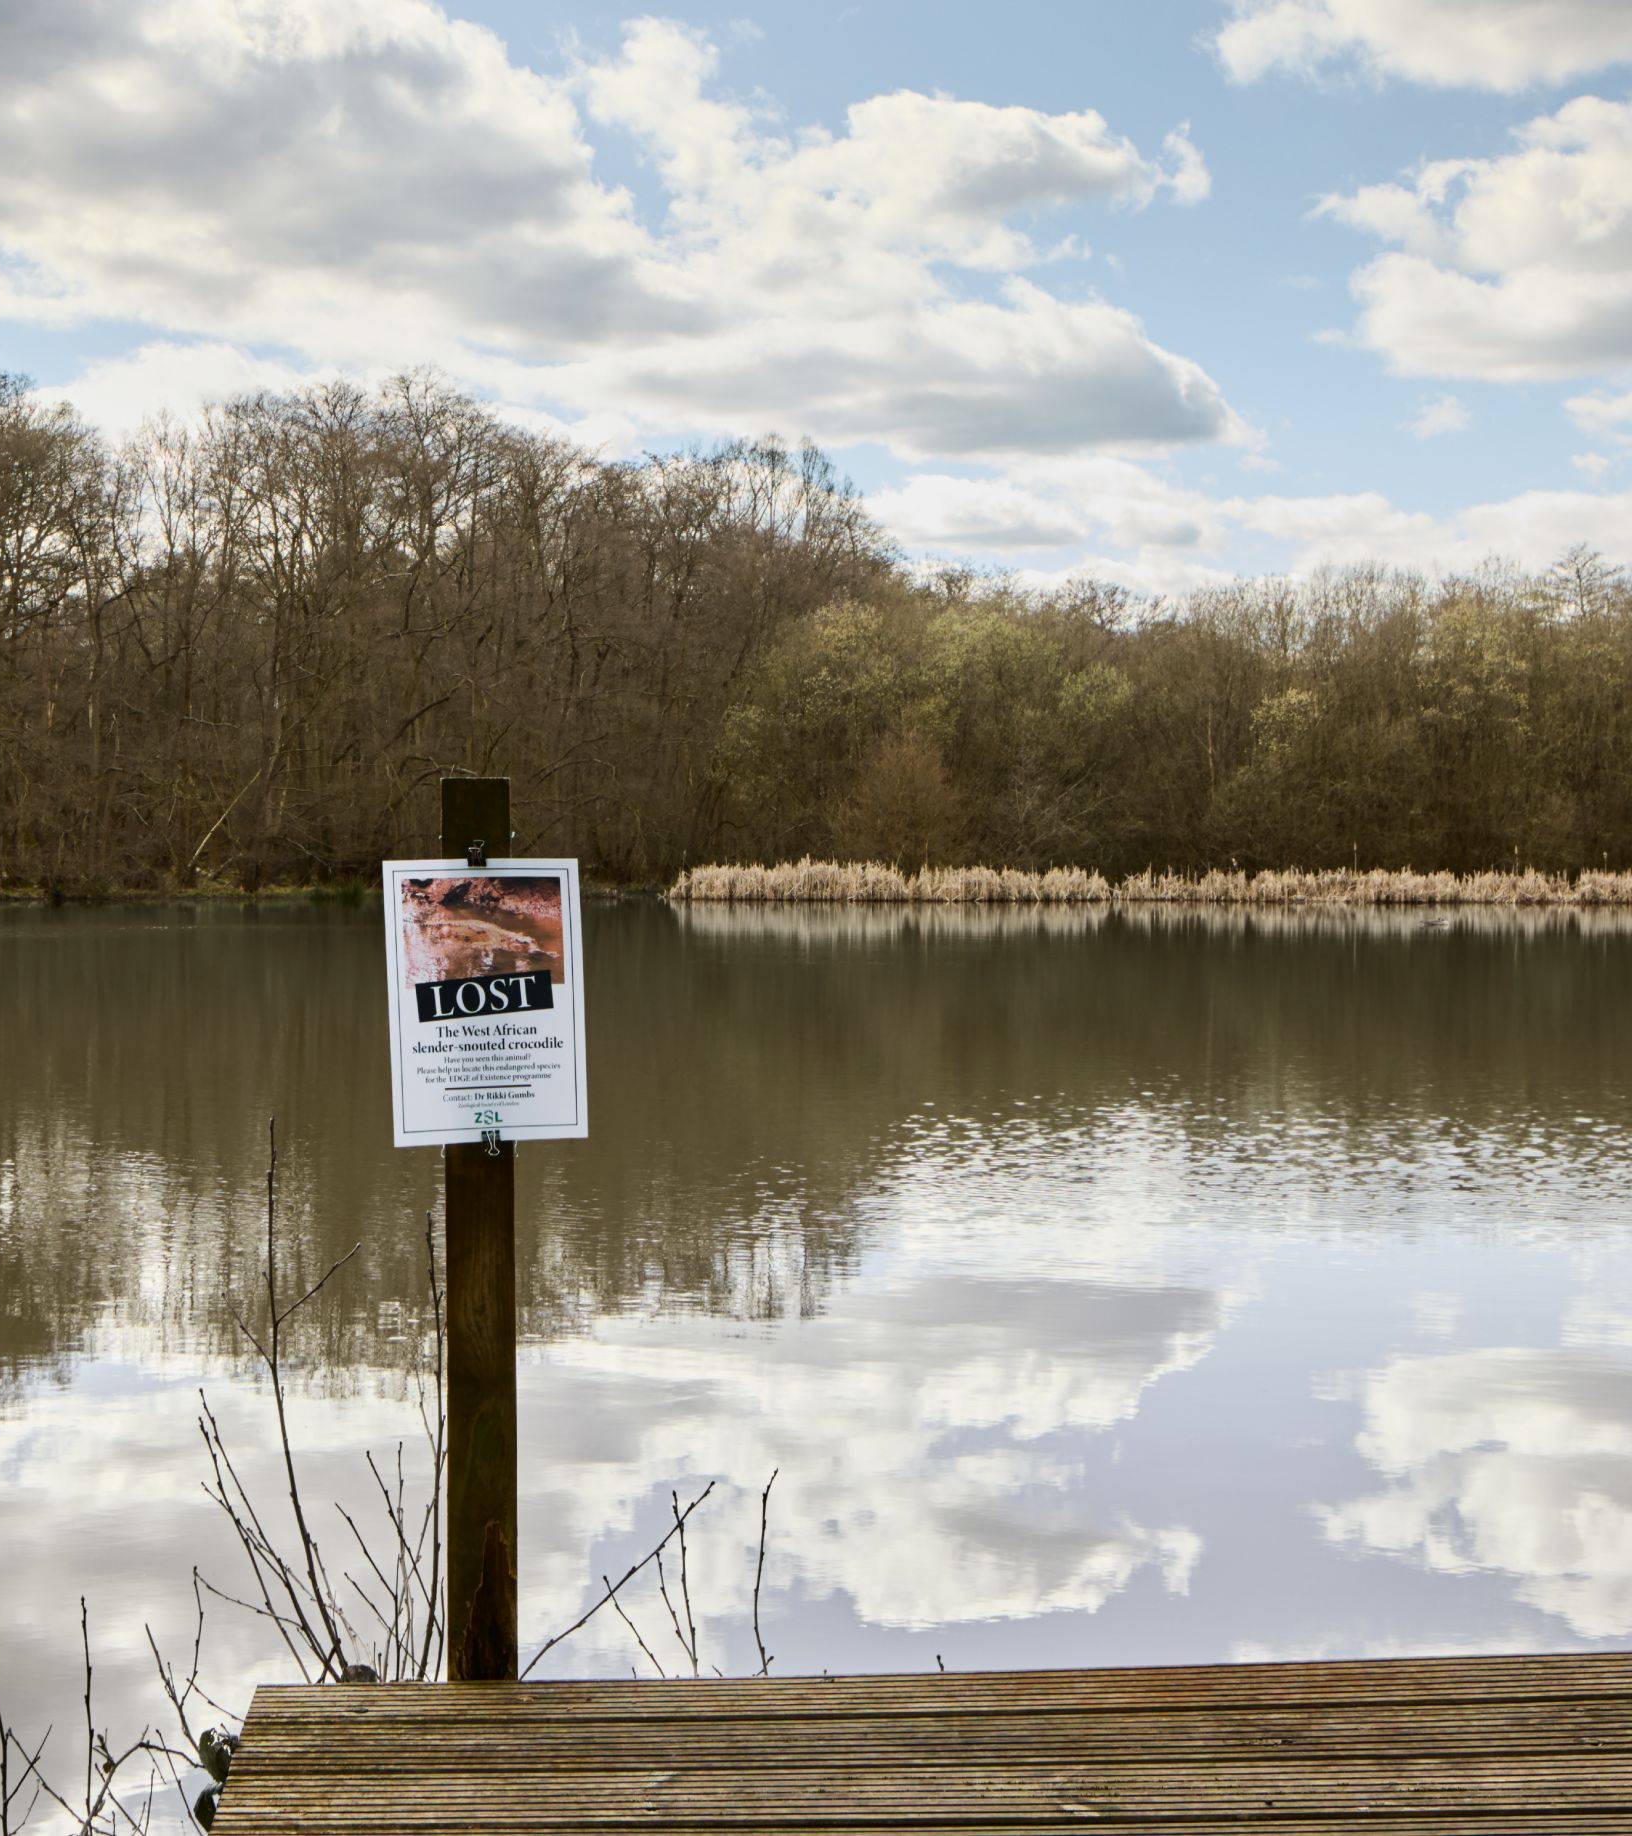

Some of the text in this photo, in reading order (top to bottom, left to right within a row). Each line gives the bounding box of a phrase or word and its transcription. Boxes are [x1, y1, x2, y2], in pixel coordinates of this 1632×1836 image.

[430, 975, 536, 1018] LOST
[436, 1023, 537, 1038] The West African
[412, 1036, 564, 1054] slender-snouted crocodile
[505, 1053, 531, 1061] animal?
[417, 1066, 436, 1074] Please
[438, 1066, 453, 1075] help
[462, 1065, 481, 1073] locate
[496, 1062, 535, 1072] endangered
[537, 1062, 560, 1071] species
[512, 1073, 552, 1082] programme
[443, 1090, 535, 1102] Contact: Dr Rikki Gumbs
[474, 1109, 503, 1125] ZSL
